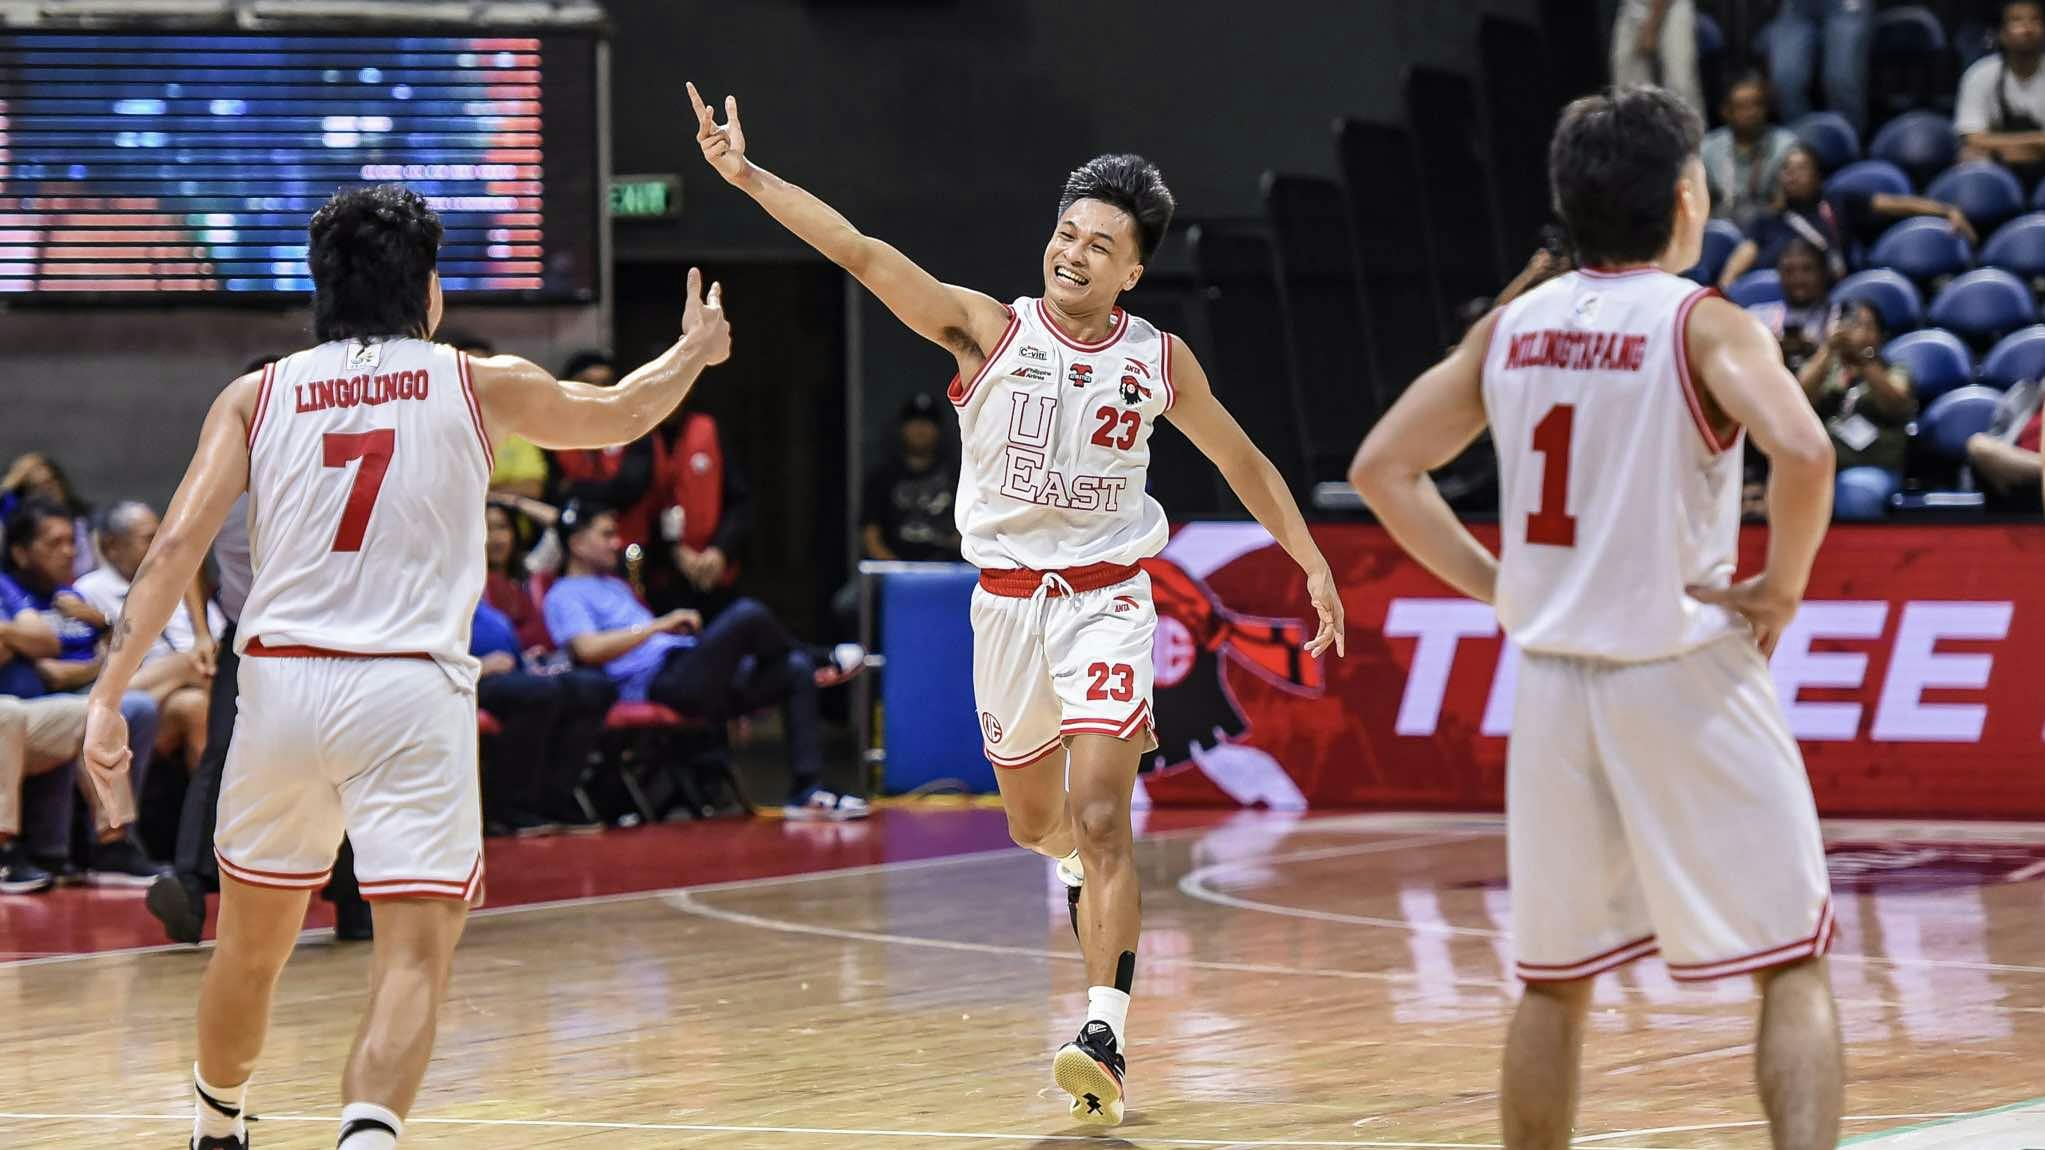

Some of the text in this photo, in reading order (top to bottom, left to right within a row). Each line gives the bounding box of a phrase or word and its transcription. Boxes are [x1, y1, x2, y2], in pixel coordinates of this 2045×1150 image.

[295, 369, 428, 413] LINGOLINGO
[1125, 364, 1141, 375] ANTA
[1091, 405, 1142, 451] 23
[322, 428, 395, 552] 7
[1001, 445, 1126, 512] EAST
[1525, 402, 1578, 547] 1
[1115, 604, 1130, 613] ANTA
[1086, 662, 1134, 702] 23
[1383, 598, 2014, 742] TEE
